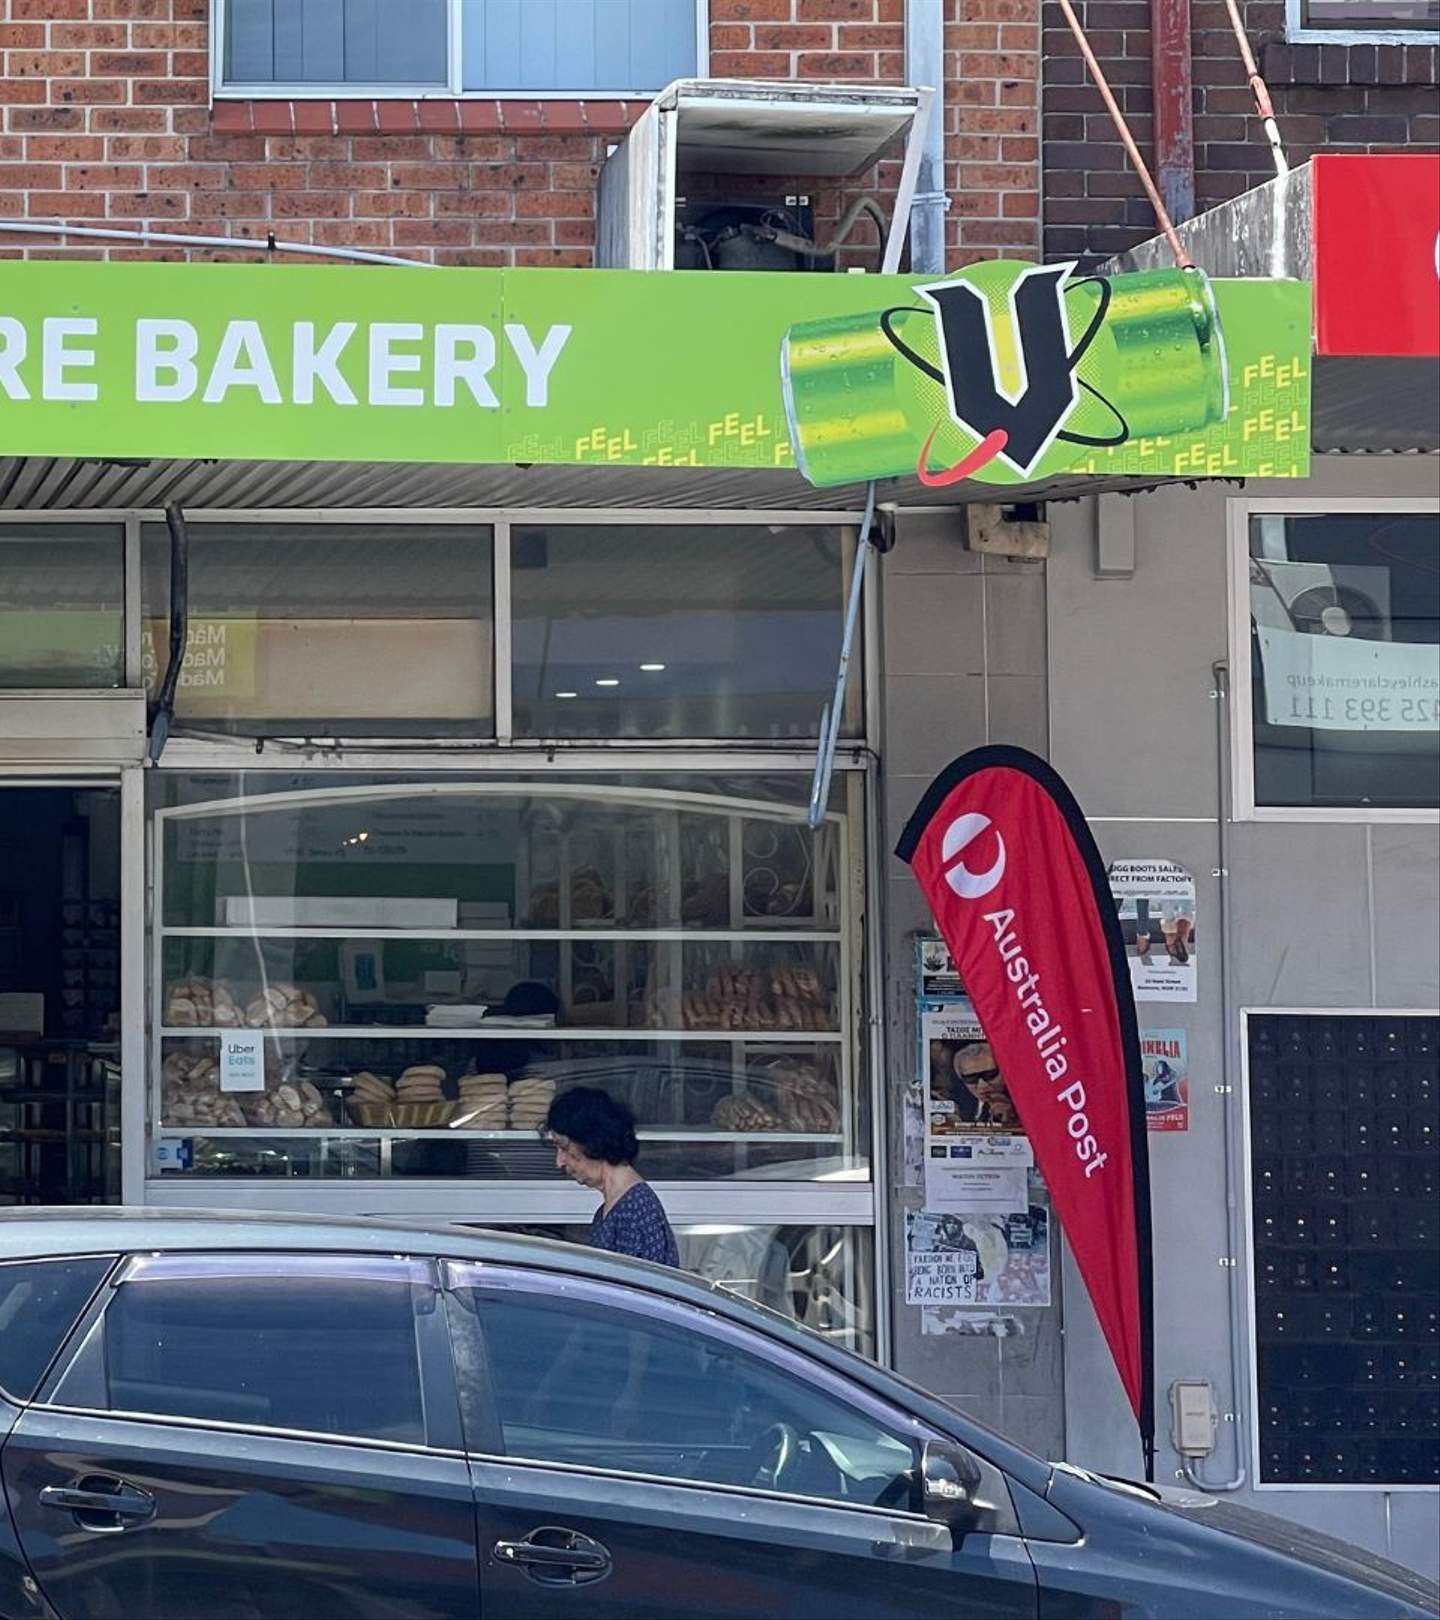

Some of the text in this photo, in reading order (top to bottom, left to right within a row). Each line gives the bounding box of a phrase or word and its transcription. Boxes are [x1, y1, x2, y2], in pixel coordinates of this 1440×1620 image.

[136, 319, 572, 407] BAKERY
[1244, 356, 1306, 387] FEEL
[709, 412, 770, 446] FEEL
[1244, 409, 1306, 441] FEEL
[575, 427, 637, 460] FEEL
[1175, 443, 1237, 475] FEEL
[1132, 875, 1154, 883] FROM
[228, 1044, 255, 1054] Uber
[983, 909, 1068, 1082] Australia
[1057, 1080, 1108, 1178] Post
[228, 1056, 255, 1066] Eats
[914, 1285, 972, 1299] RACISTS
